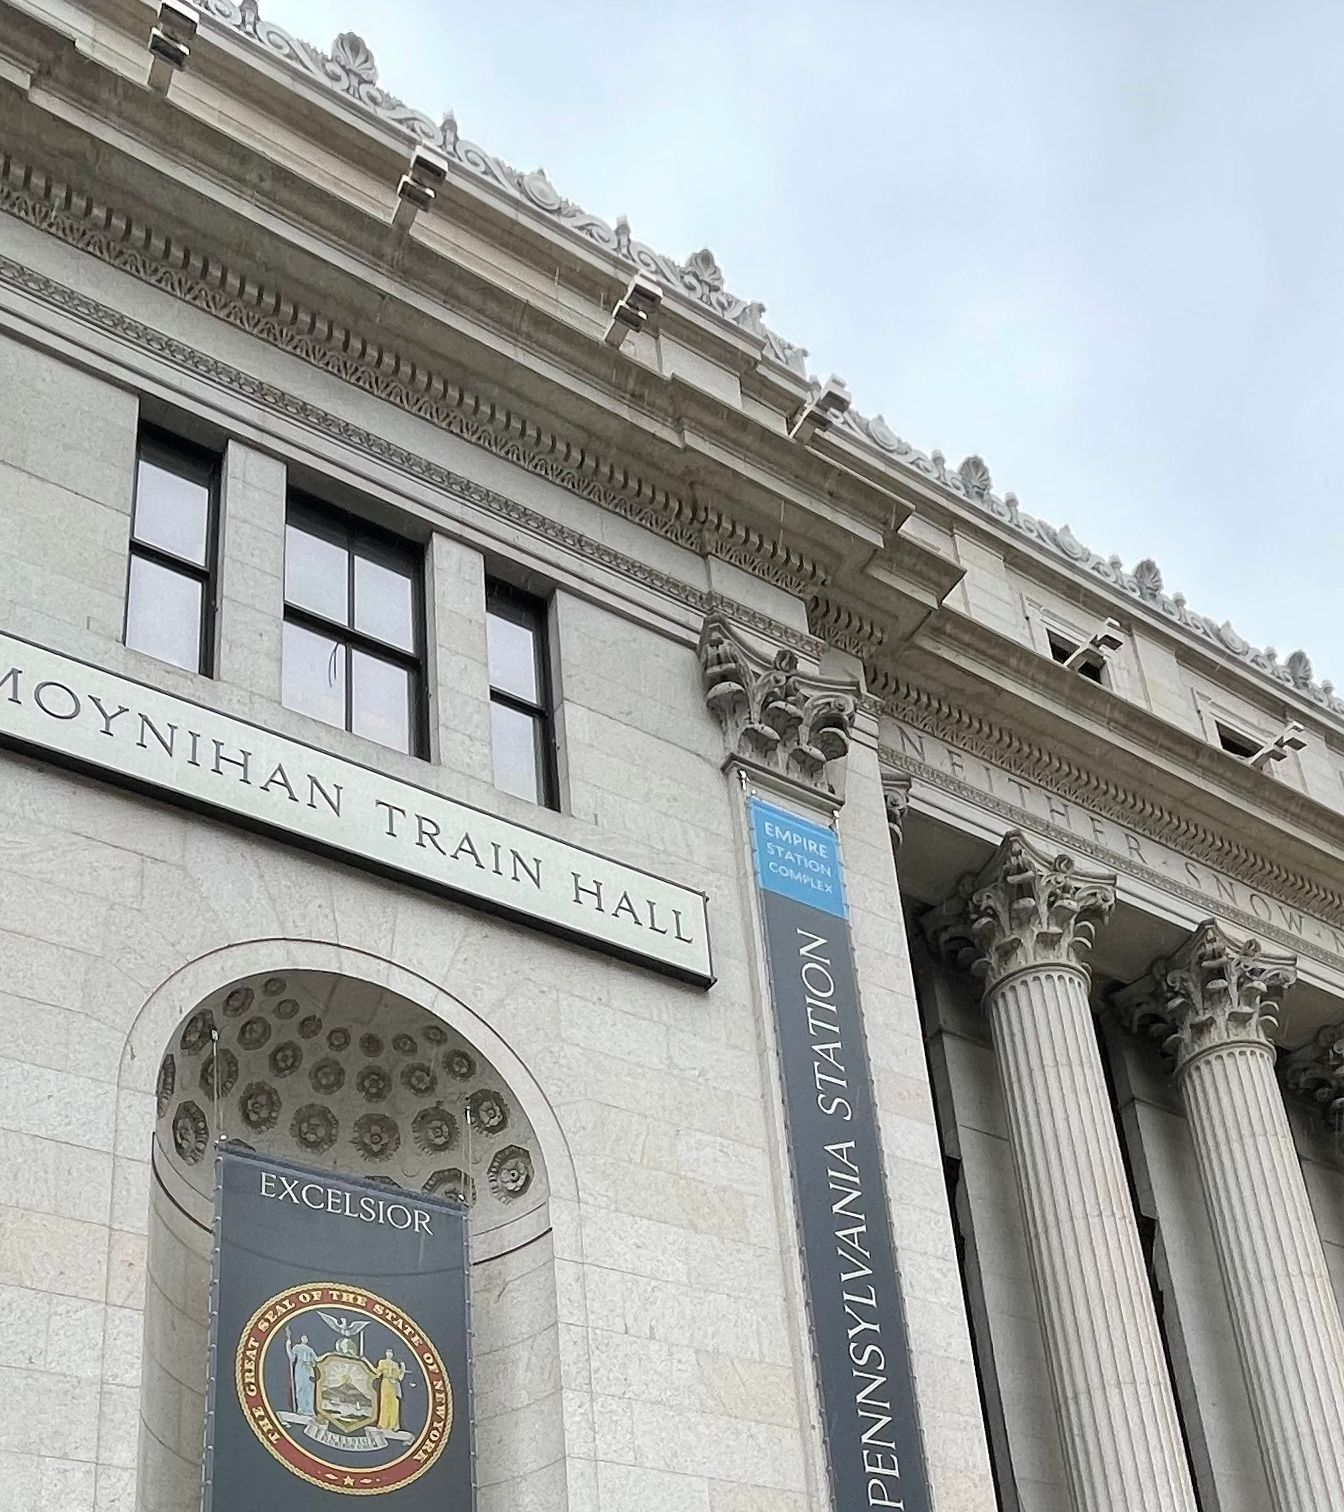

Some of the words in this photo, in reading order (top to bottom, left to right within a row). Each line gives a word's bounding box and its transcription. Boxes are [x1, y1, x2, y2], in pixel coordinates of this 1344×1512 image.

[764, 822, 827, 859] EMPIRE
[898, 725, 1150, 865] NEITHER
[1183, 861, 1308, 932] SNOW
[375, 799, 543, 890] TRAIN
[570, 870, 694, 945] HALL
[766, 843, 831, 878] STATION
[768, 861, 833, 894] COMPLEX
[796, 928, 852, 1121] STATION
[260, 1171, 433, 1236] EXCELSIOR
[258, 1299, 296, 1333] SEAL
[298, 1290, 323, 1304] OF
[329, 1290, 367, 1307] THE
[372, 1304, 424, 1347] STATE
[824, 1140, 904, 1511] PENNSYLVANIA
[245, 1337, 260, 1397] GREAT
[422, 1352, 440, 1374] OF
[432, 1380, 447, 1418] NEW
[251, 1406, 281, 1445] THE
[413, 1417, 447, 1463] YORK
